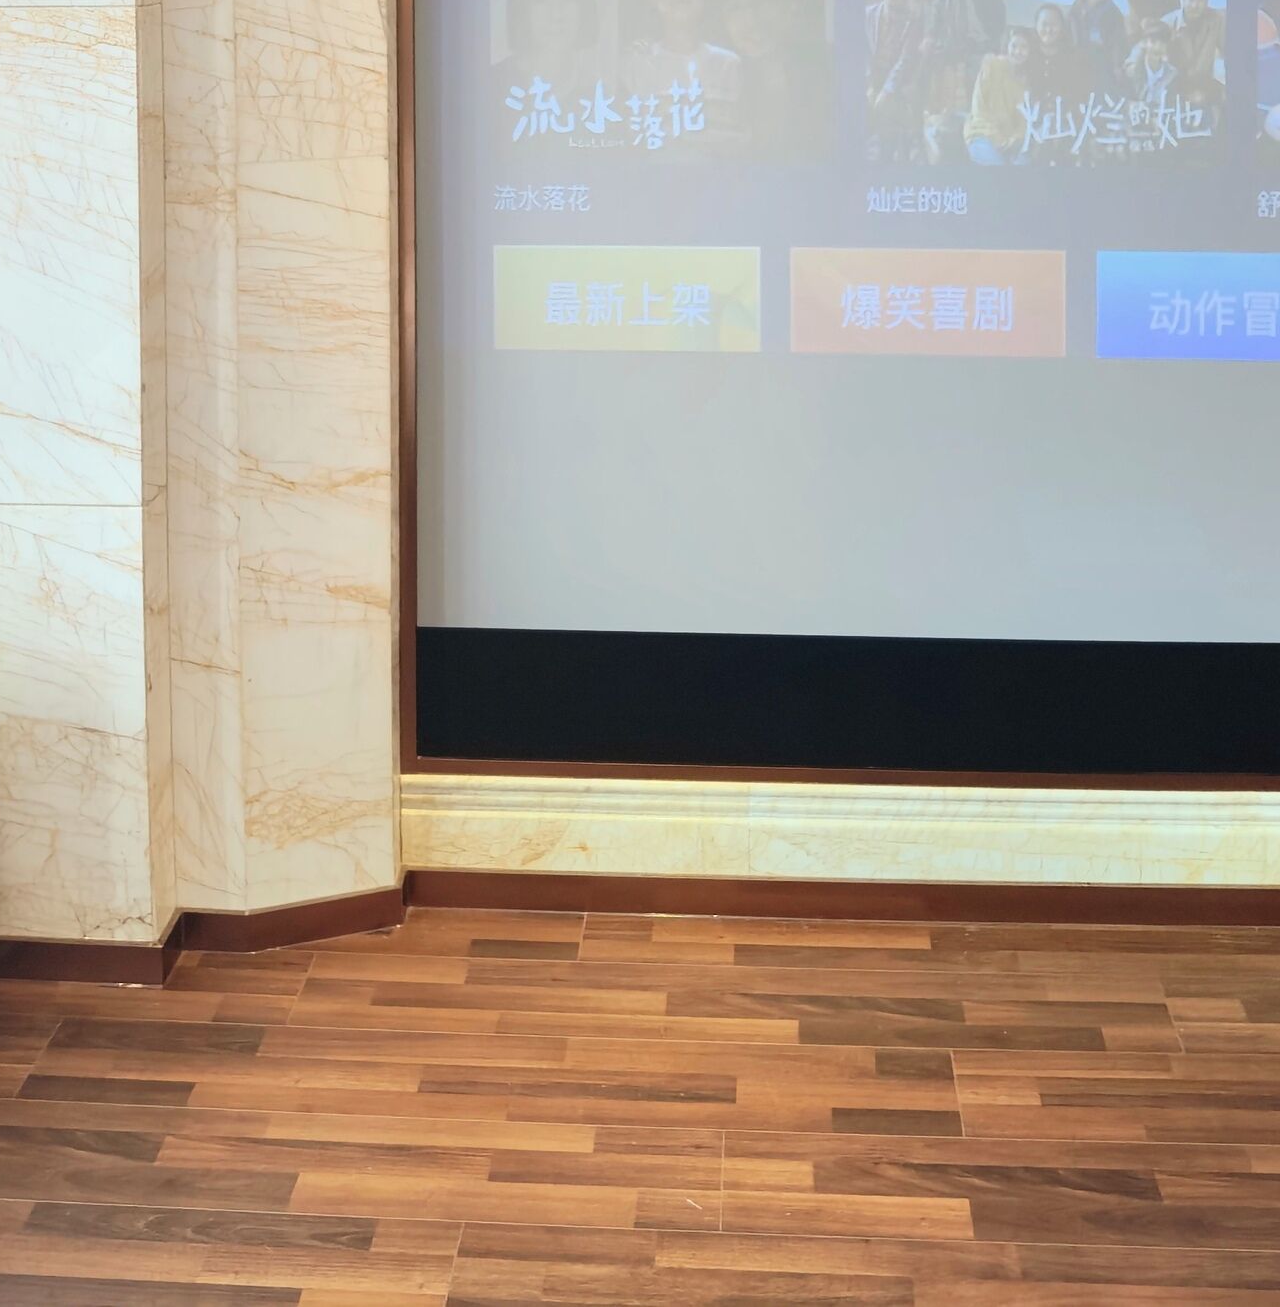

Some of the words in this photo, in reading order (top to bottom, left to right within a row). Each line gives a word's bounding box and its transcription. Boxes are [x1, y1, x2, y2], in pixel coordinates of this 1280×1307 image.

[505, 61, 705, 150] 流水落花
[1016, 88, 1212, 154] 灿烂的她
[494, 184, 591, 212] 流水落花
[867, 186, 968, 215] 灿烂的她
[543, 281, 712, 328] 最新上架
[840, 285, 1015, 333] 爆笑喜剧
